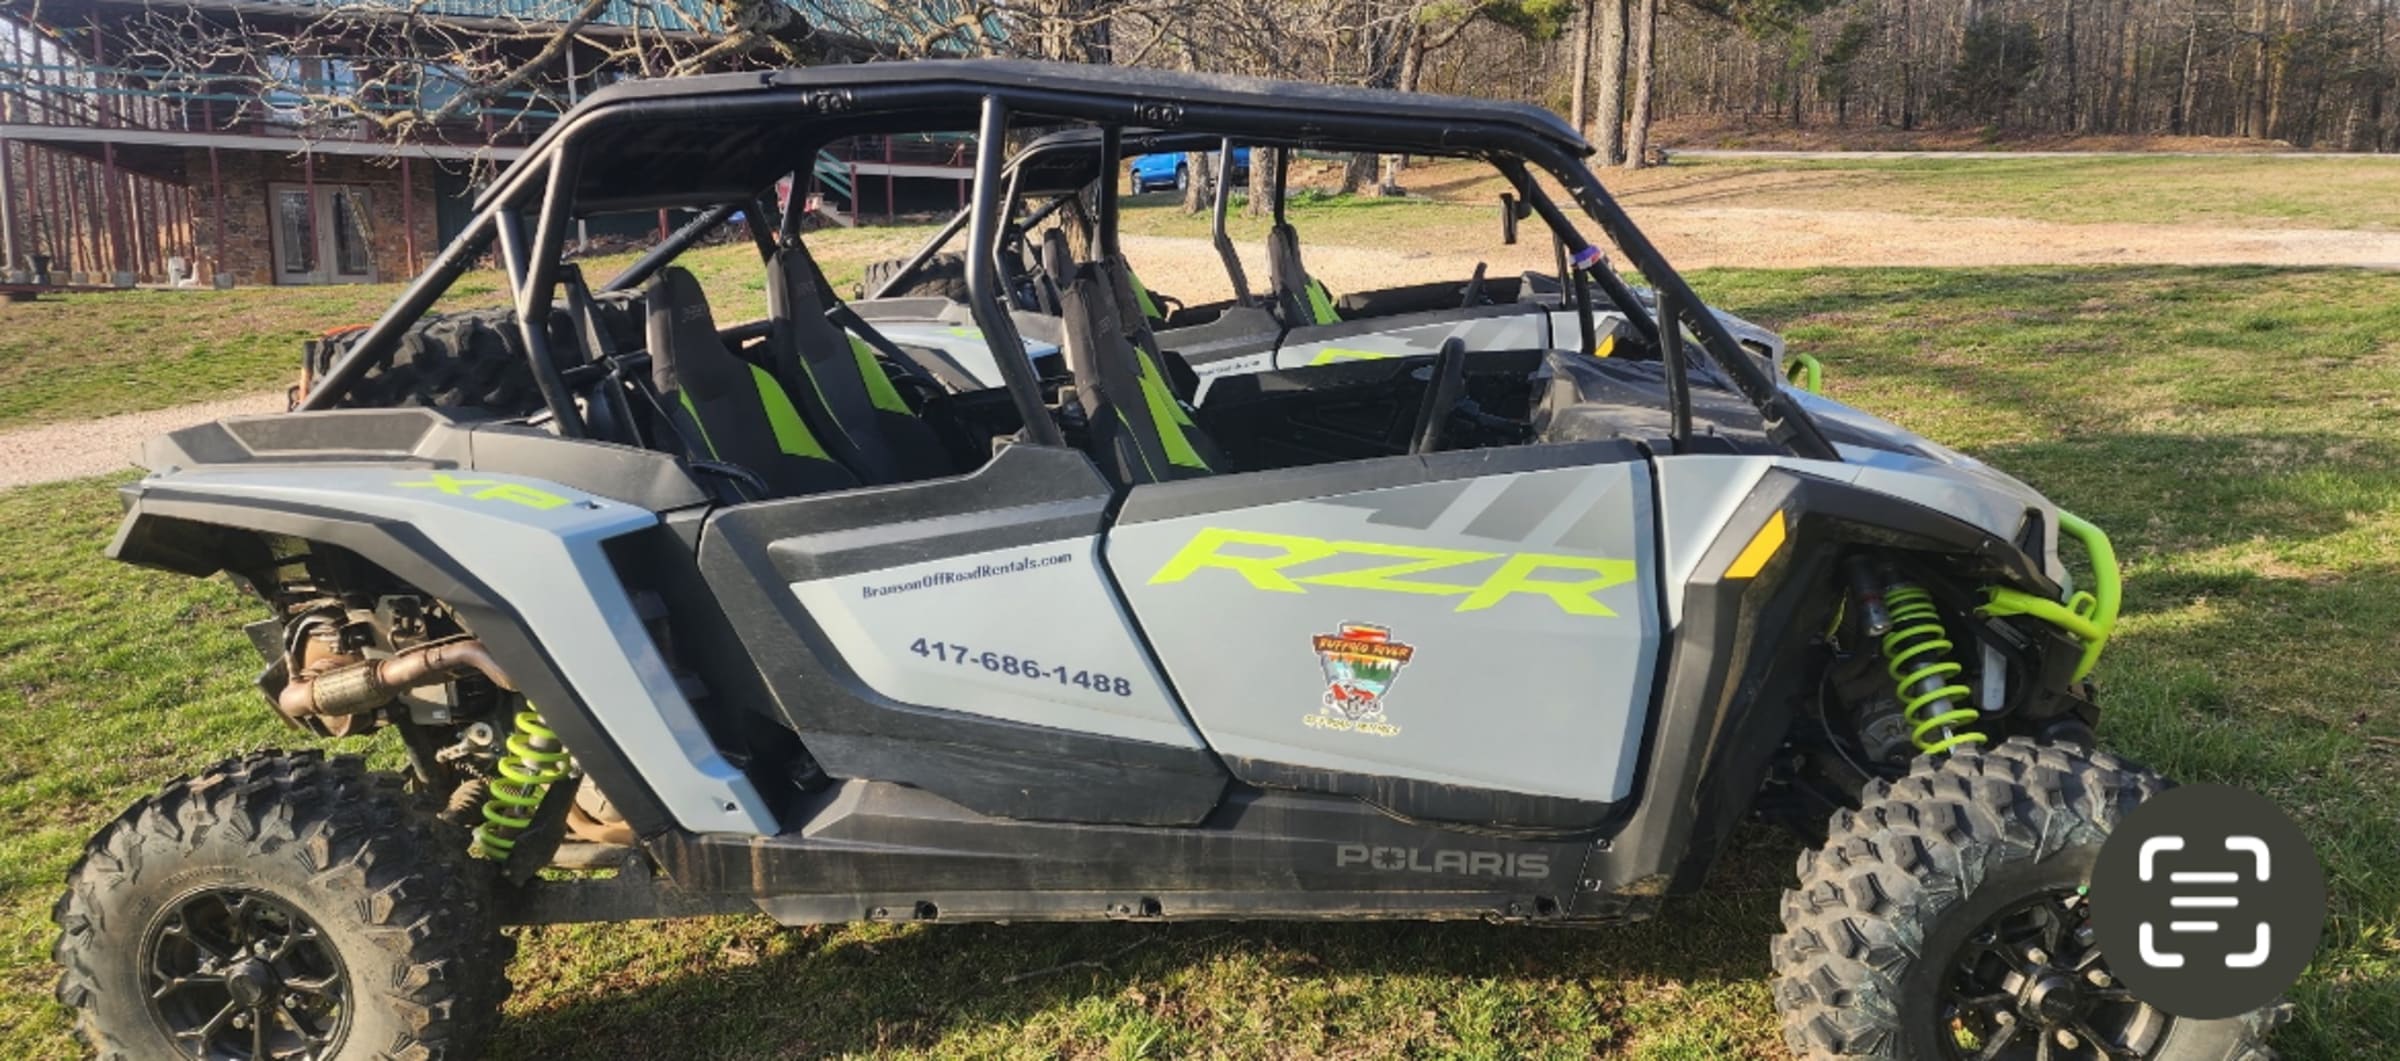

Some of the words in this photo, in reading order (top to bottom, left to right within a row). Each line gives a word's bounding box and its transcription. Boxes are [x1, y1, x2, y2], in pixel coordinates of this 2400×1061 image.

[862, 551, 1072, 599] BransonOffRoadRentals.com
[1147, 527, 1636, 617] RZR
[910, 637, 1132, 697] 417-686-1488
[1336, 844, 1550, 879] POLARIS
